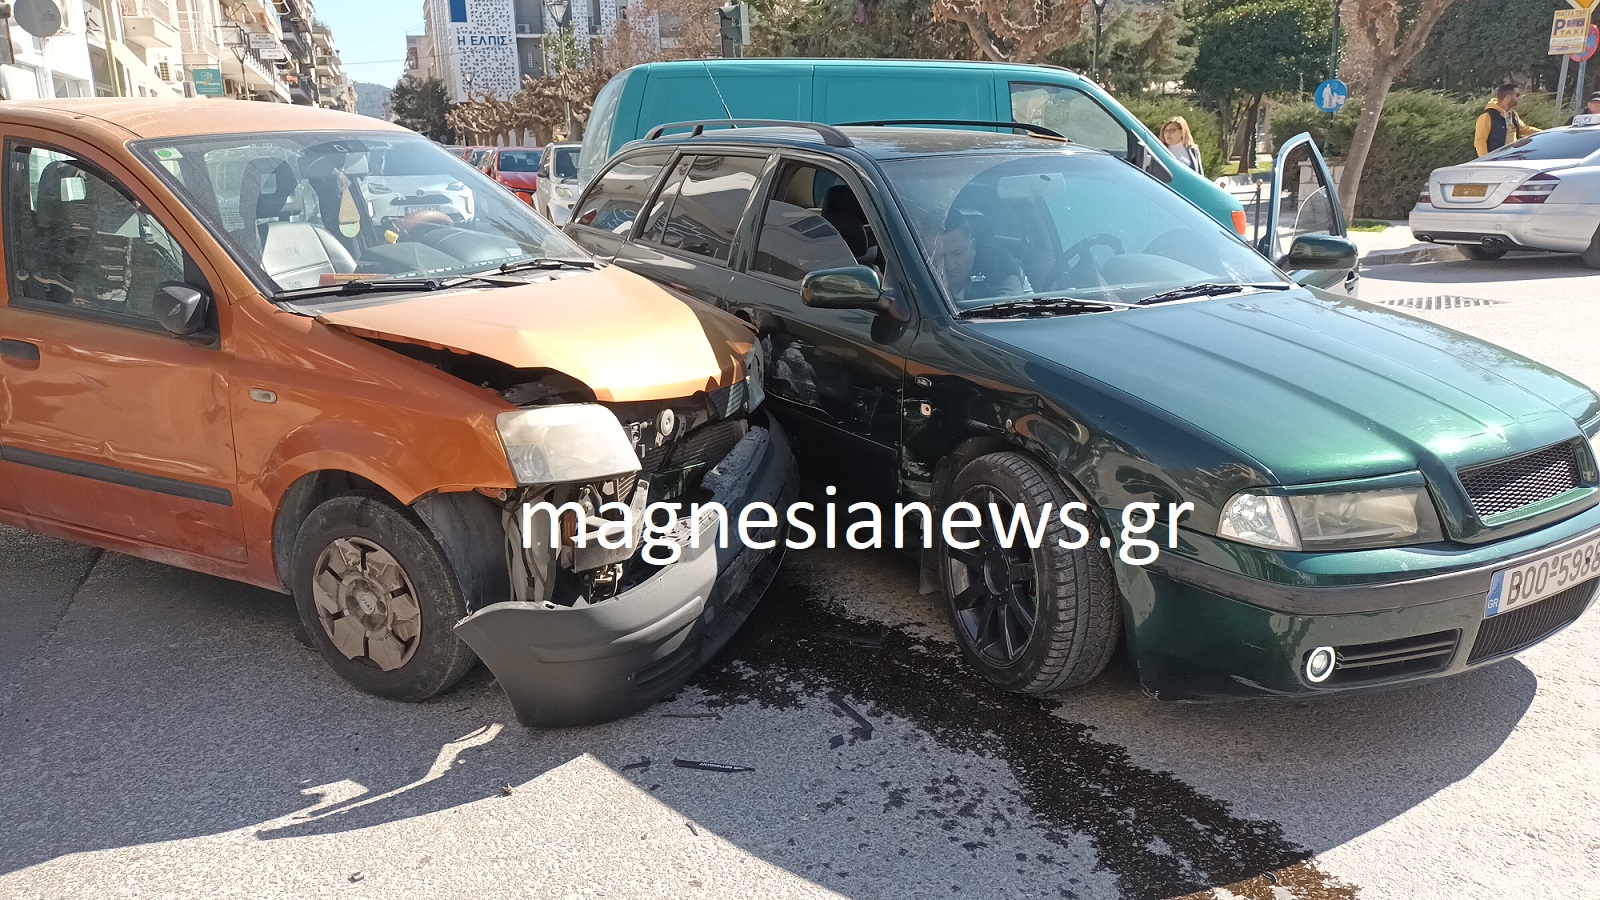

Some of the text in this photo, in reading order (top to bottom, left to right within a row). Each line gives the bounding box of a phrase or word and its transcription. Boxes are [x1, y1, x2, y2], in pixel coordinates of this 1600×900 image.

[1553, 18, 1567, 36] P
[457, 35, 508, 46] Η ΕΛΠΙΣ
[1487, 598, 1499, 609] GR
